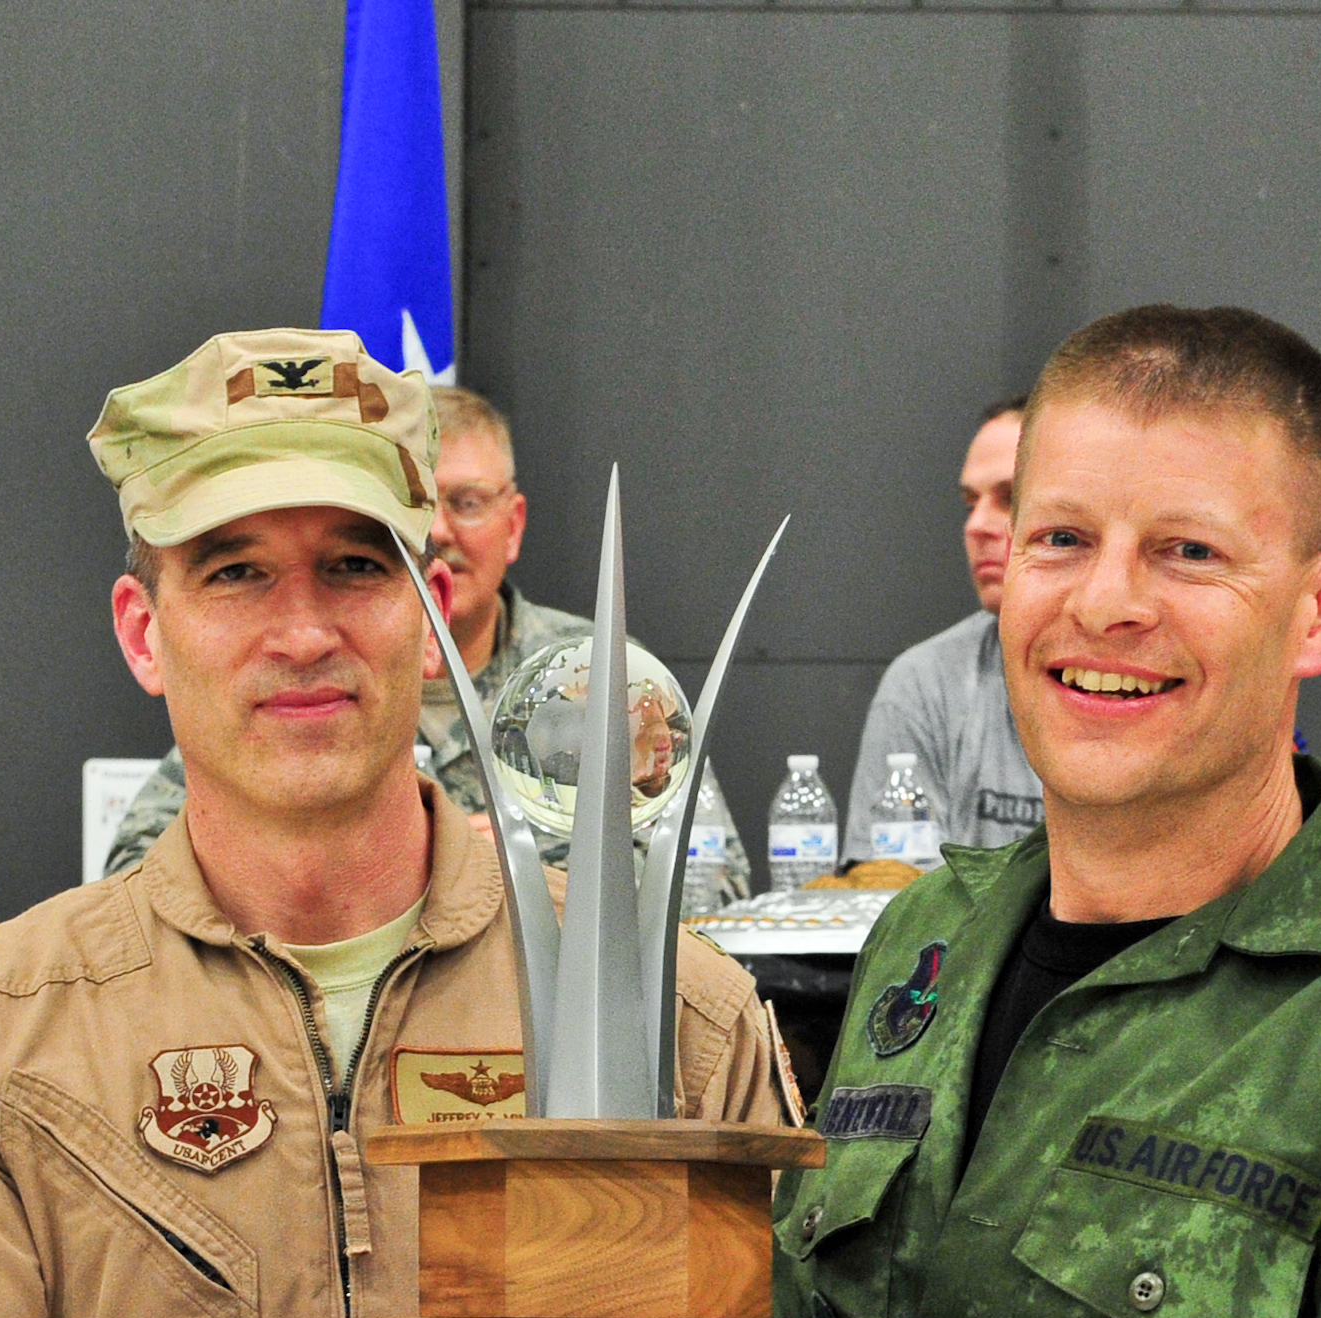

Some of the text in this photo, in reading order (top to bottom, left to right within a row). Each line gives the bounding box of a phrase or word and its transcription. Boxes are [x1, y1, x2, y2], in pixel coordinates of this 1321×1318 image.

[426, 1112, 479, 1123] JEFFREY
[173, 1140, 247, 1167] USAFCENT
[1073, 1123, 1321, 1231] U.S. AIR FORCE
